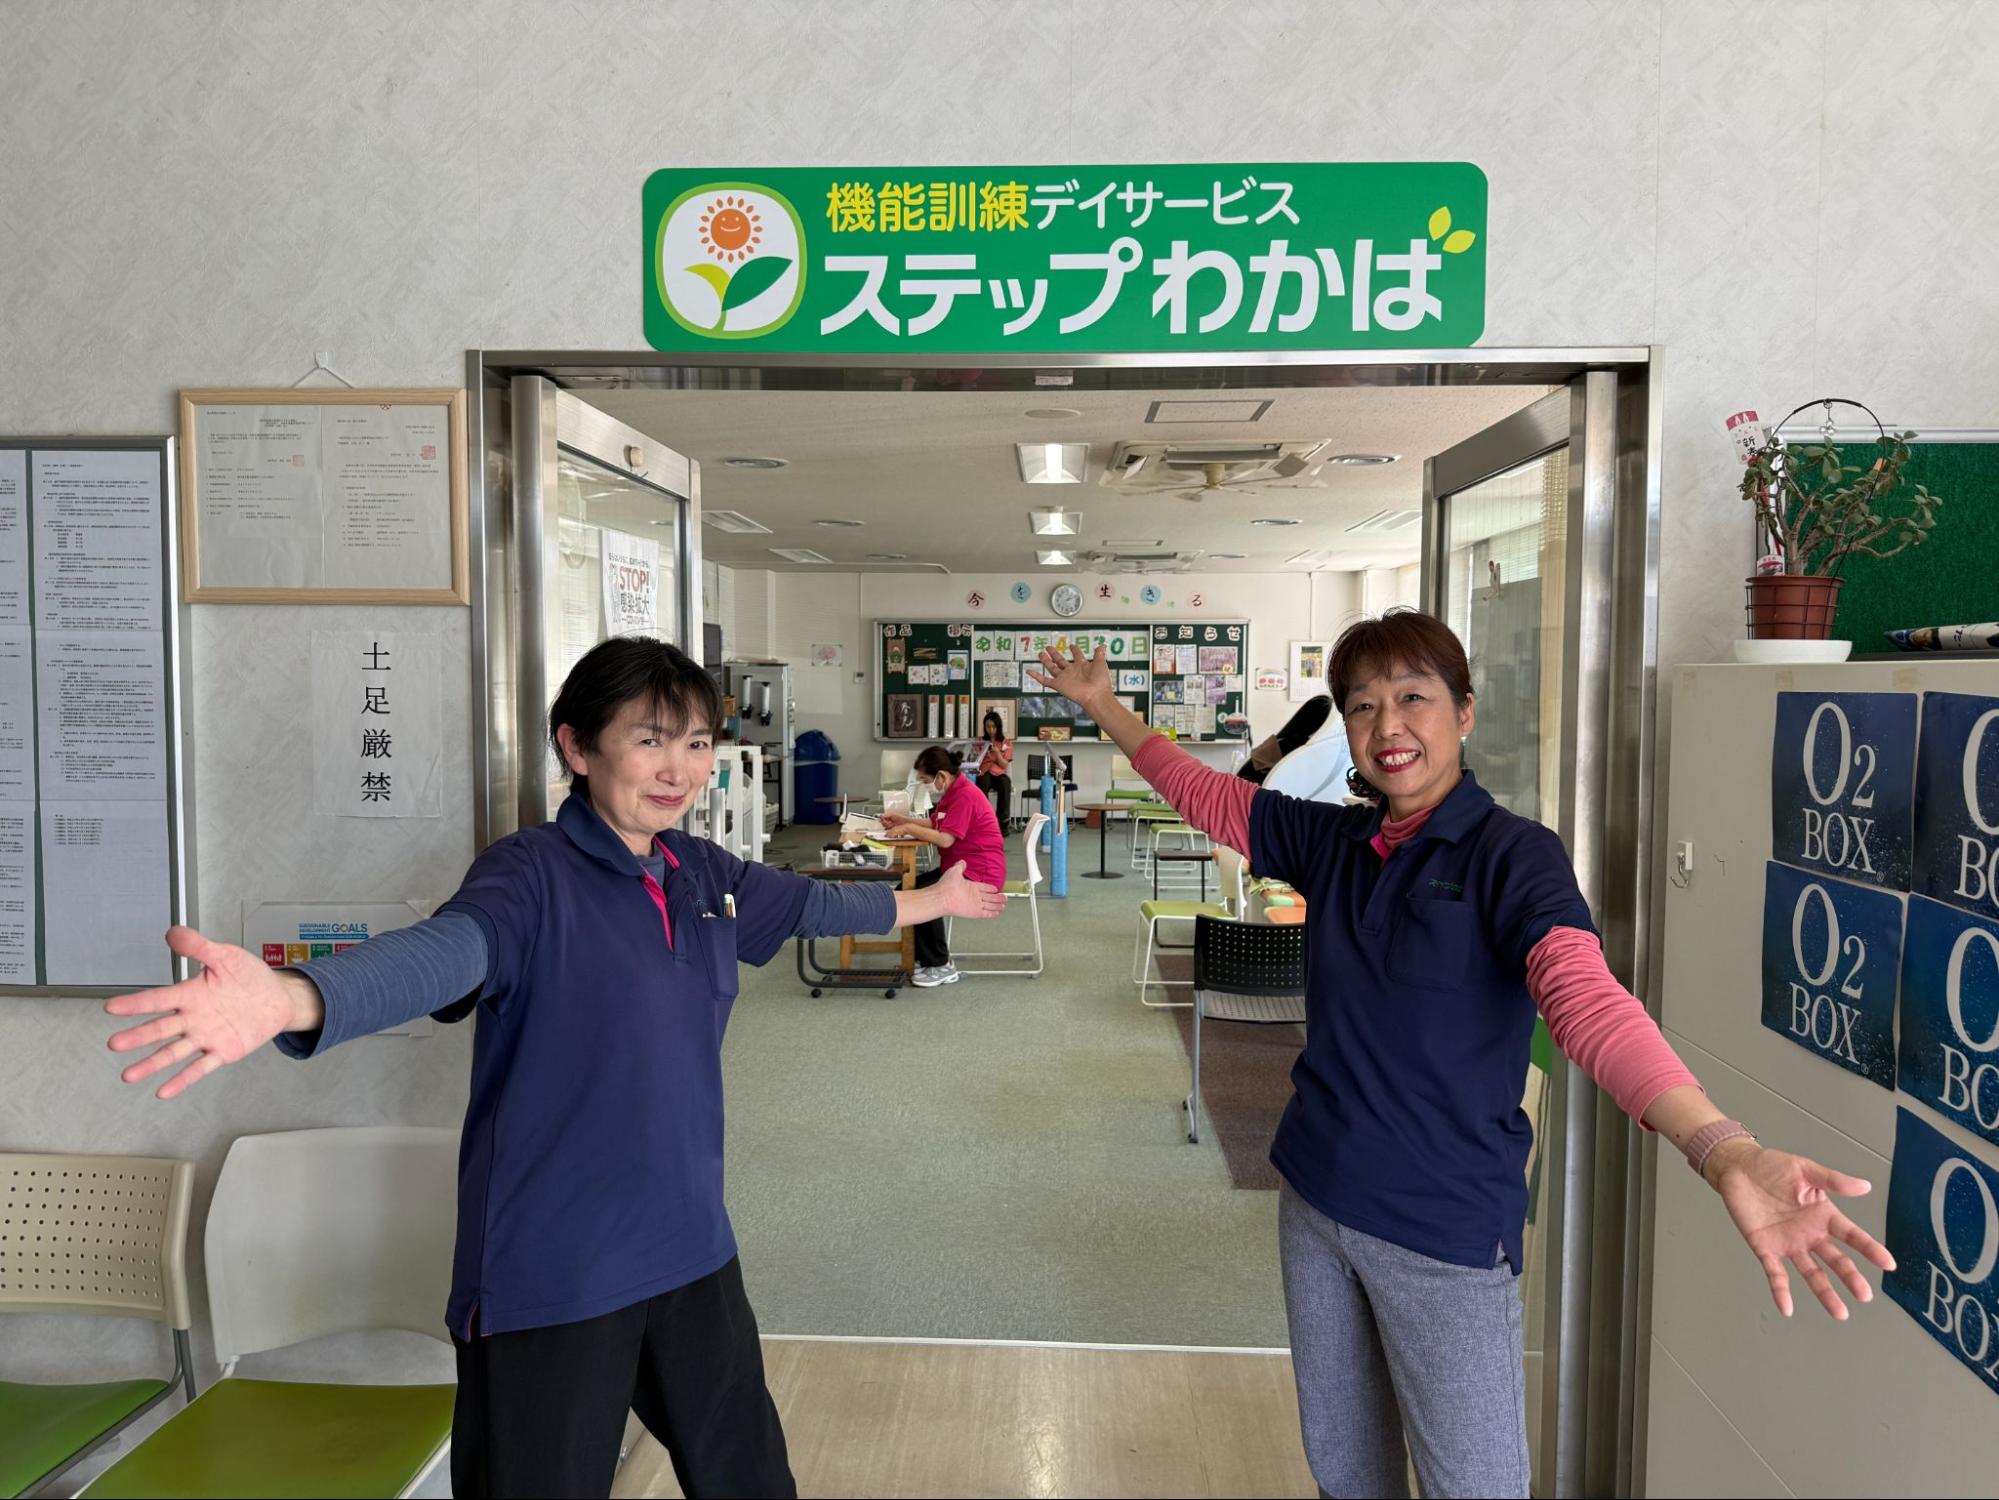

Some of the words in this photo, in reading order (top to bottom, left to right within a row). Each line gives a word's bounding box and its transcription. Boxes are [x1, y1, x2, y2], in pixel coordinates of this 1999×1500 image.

[826, 180, 1300, 232] 機能訓練デイサービス
[821, 237, 1443, 336] ステップわかば
[620, 566, 650, 593] STOP!
[1155, 626, 1240, 641] お知らせ
[361, 642, 392, 802] 土足厳禁
[1803, 702, 1876, 808] O2
[331, 923, 368, 933] GOALS
[1792, 883, 1865, 999] O2
